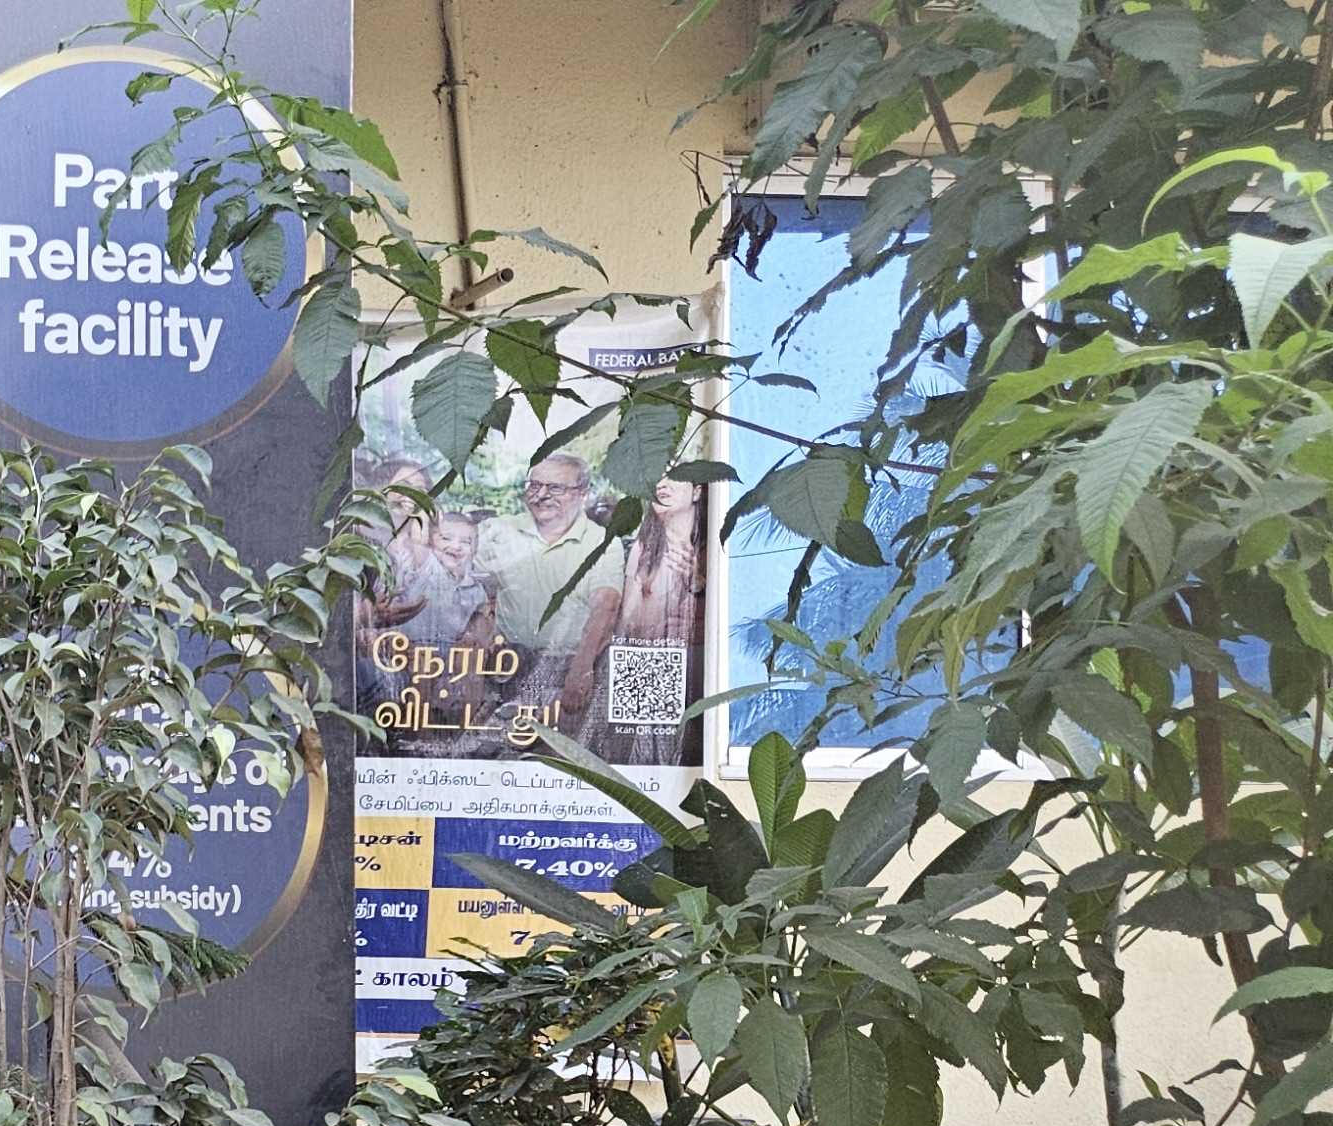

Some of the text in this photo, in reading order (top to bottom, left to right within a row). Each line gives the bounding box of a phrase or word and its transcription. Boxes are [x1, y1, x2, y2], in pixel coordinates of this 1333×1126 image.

[53, 153, 179, 211] Part
[19, 299, 223, 373] facility
[594, 353, 655, 368] FEDERAL
[613, 635, 685, 647] For more details
[372, 631, 519, 684] நேரம்
[615, 726, 677, 735] scan QR code
[359, 793, 452, 813] சேமிப்பை
[186, 800, 272, 833] ents
[380, 898, 419, 922] வட்டி
[372, 966, 454, 988] காலம்
